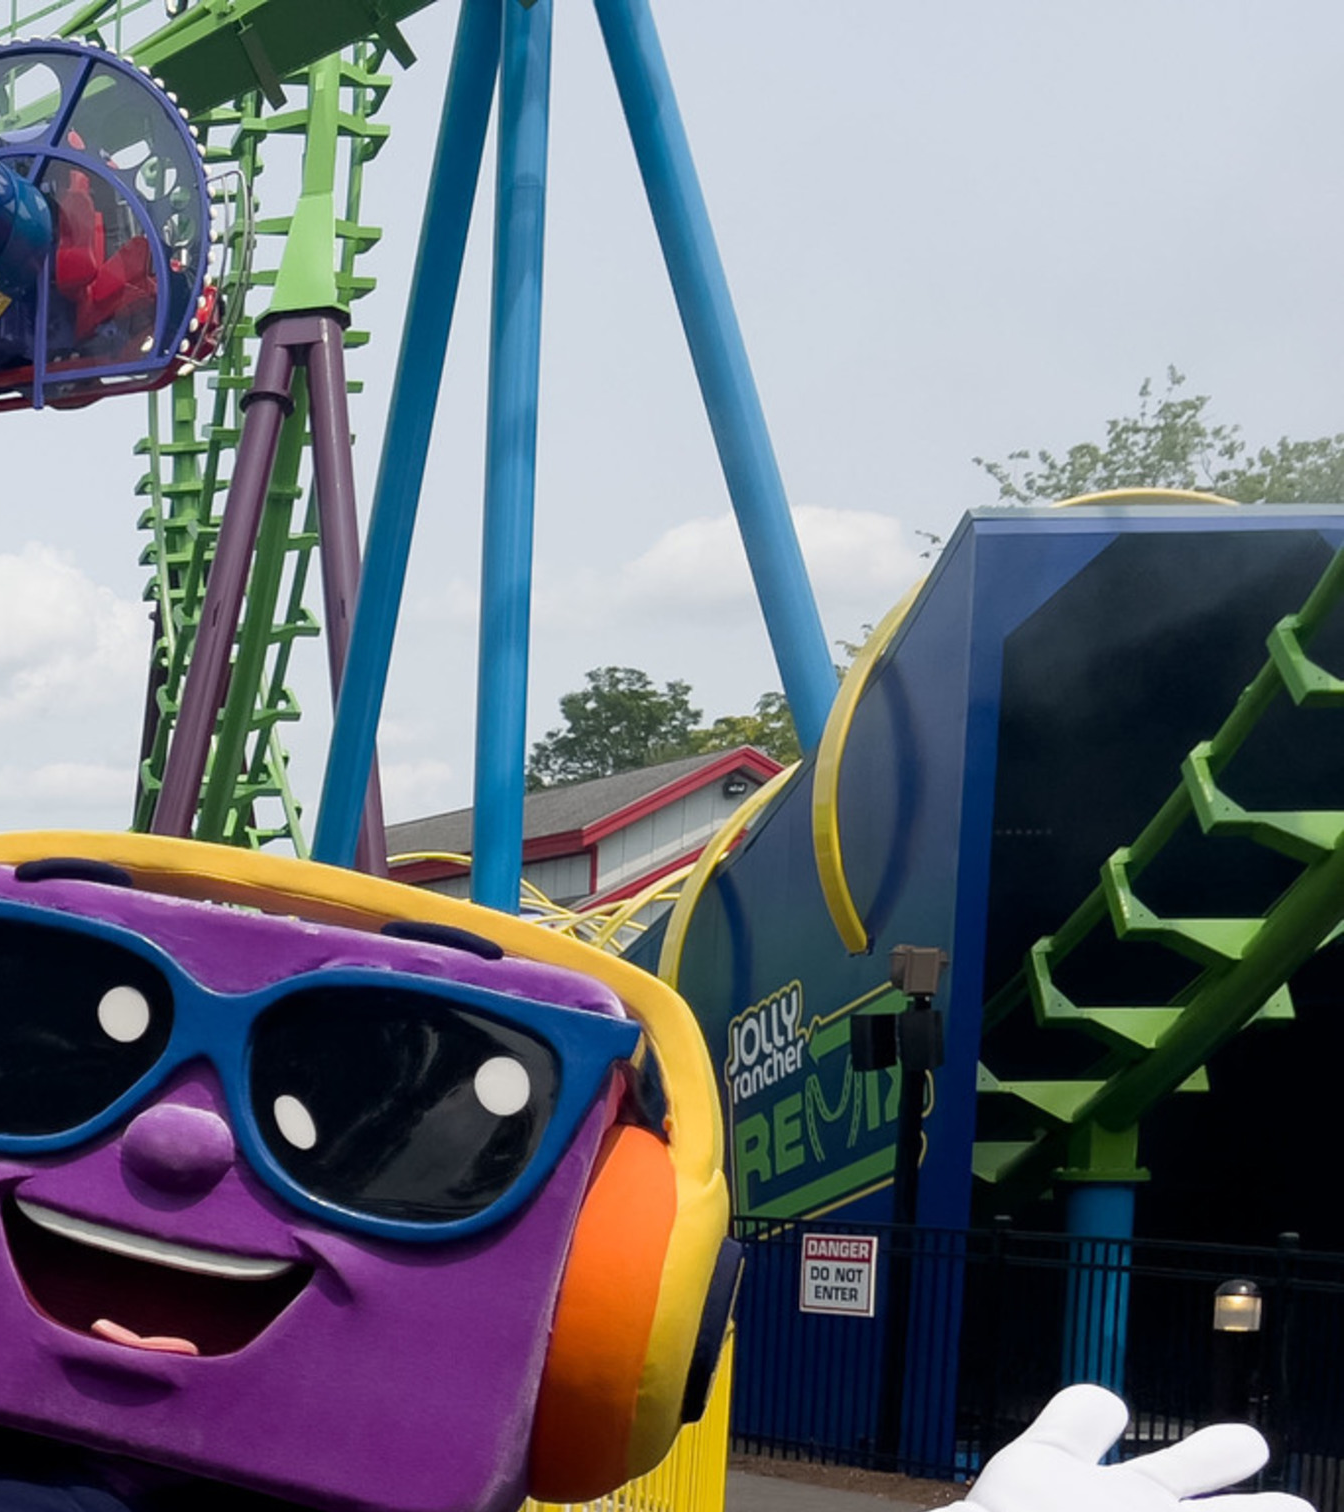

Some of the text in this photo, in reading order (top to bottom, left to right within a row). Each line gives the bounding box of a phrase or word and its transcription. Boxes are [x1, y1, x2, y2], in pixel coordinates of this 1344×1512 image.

[729, 990, 797, 1076] JOLLY
[734, 1038, 804, 1104] rancher
[807, 1240, 870, 1260] DANGER
[810, 1266, 863, 1284] DO NOT
[814, 1285, 858, 1302] ENTER
